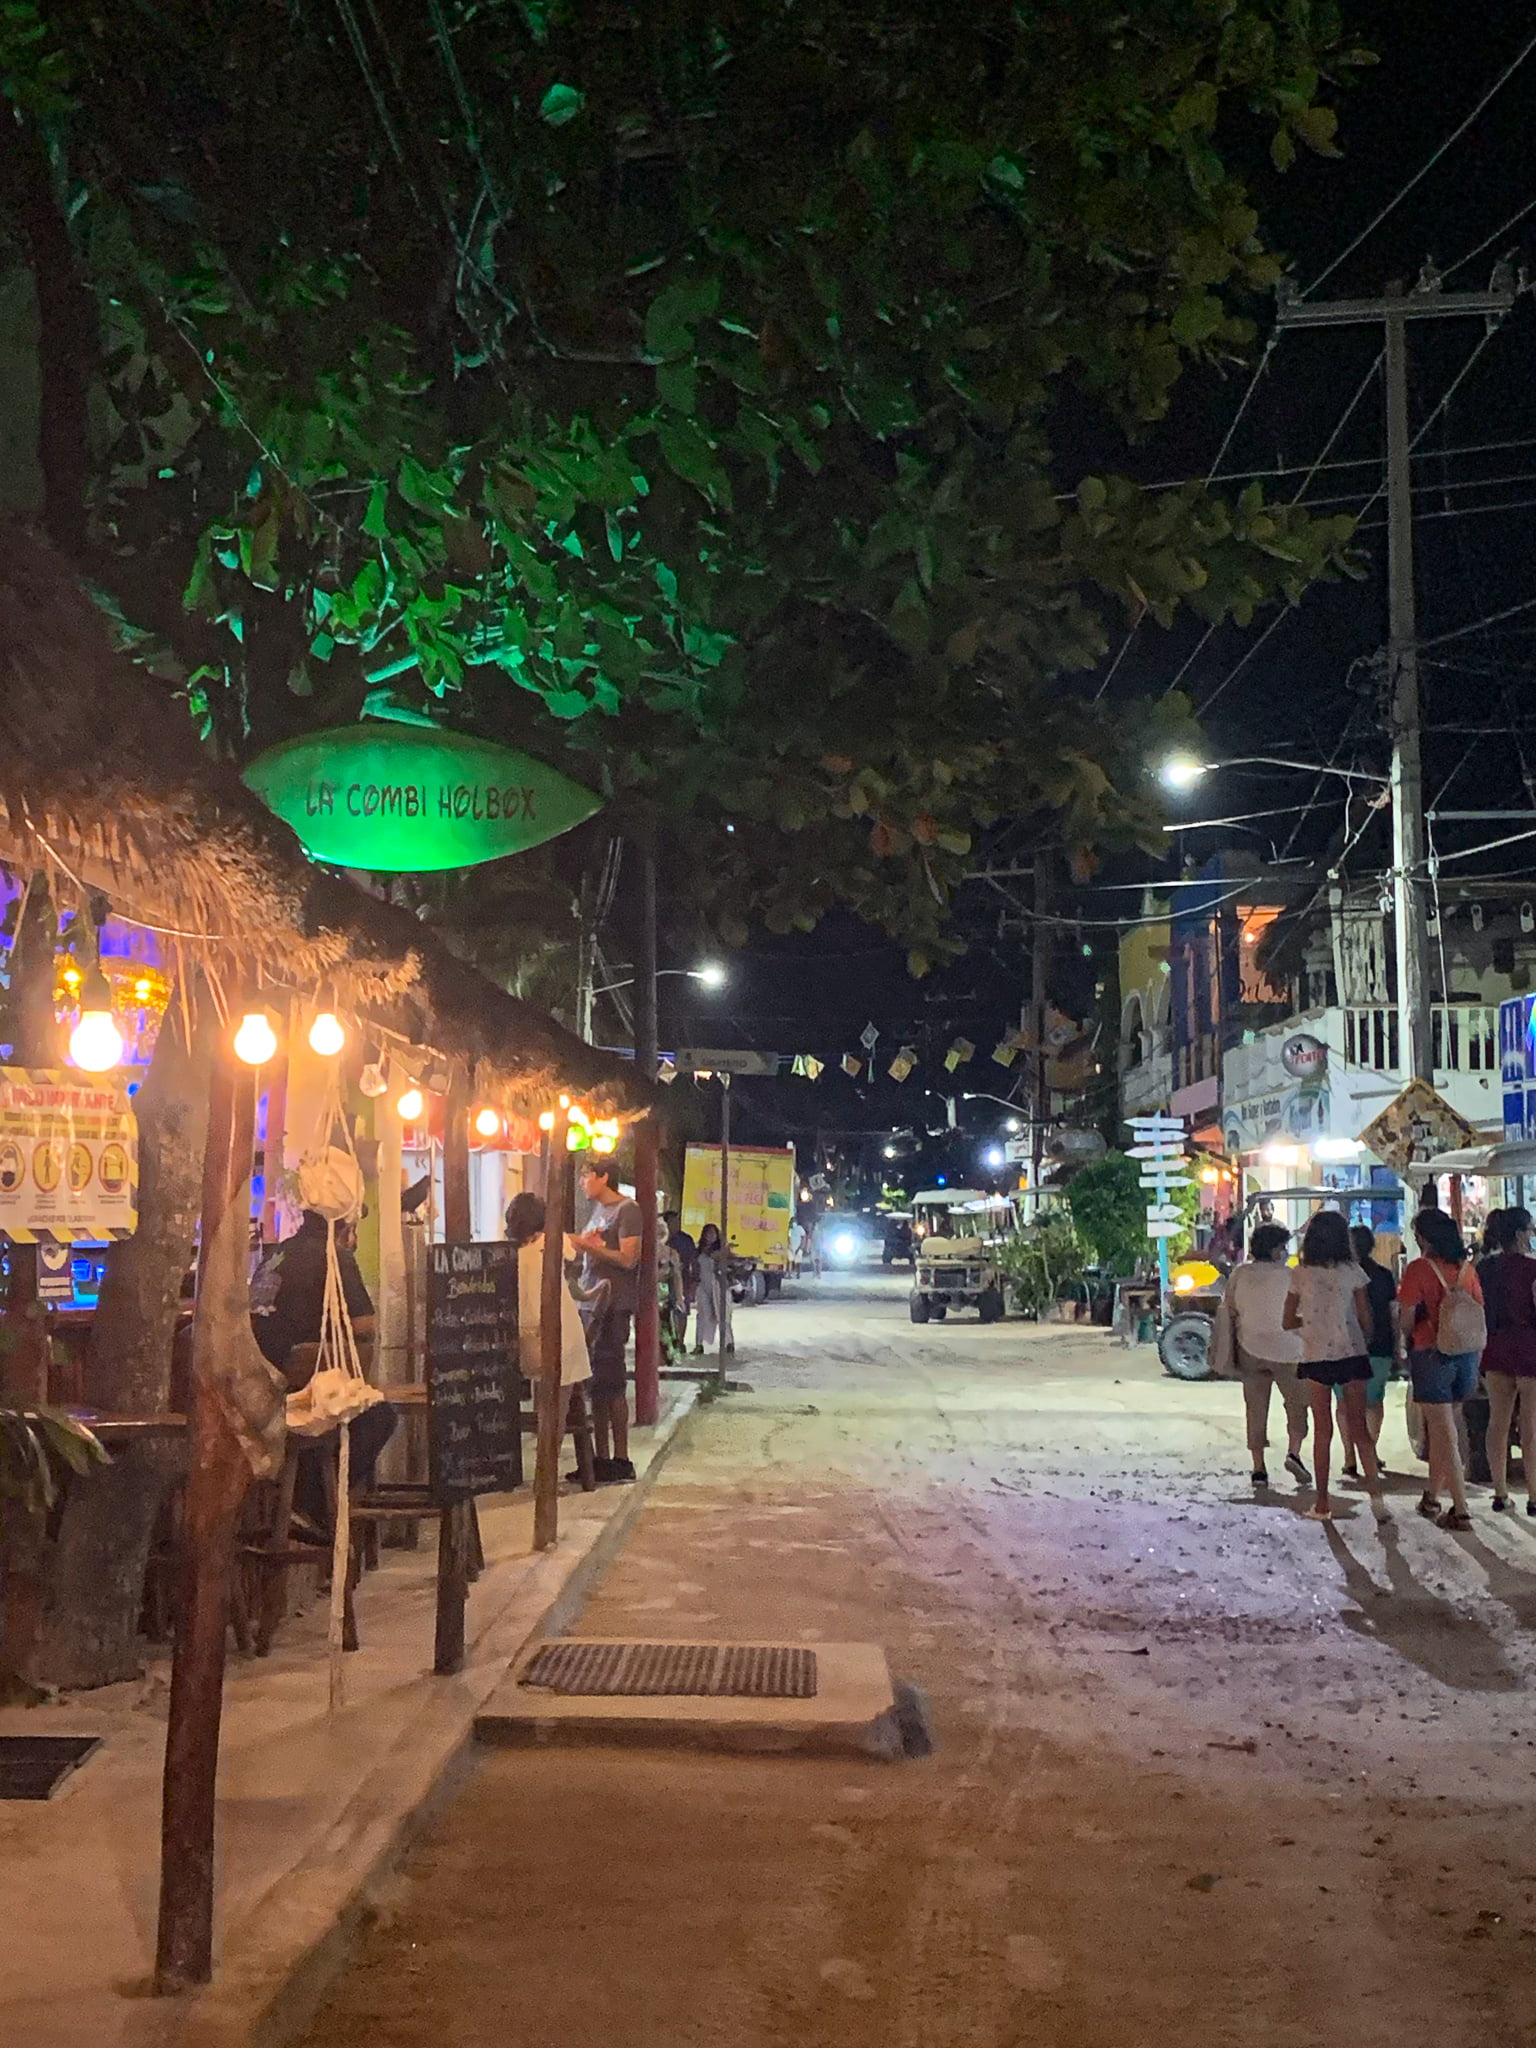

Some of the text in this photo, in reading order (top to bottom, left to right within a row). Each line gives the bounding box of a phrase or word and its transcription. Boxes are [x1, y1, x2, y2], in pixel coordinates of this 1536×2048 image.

[304, 783, 537, 821] LA COMBI HOLBOX
[434, 1248, 449, 1274] LA
